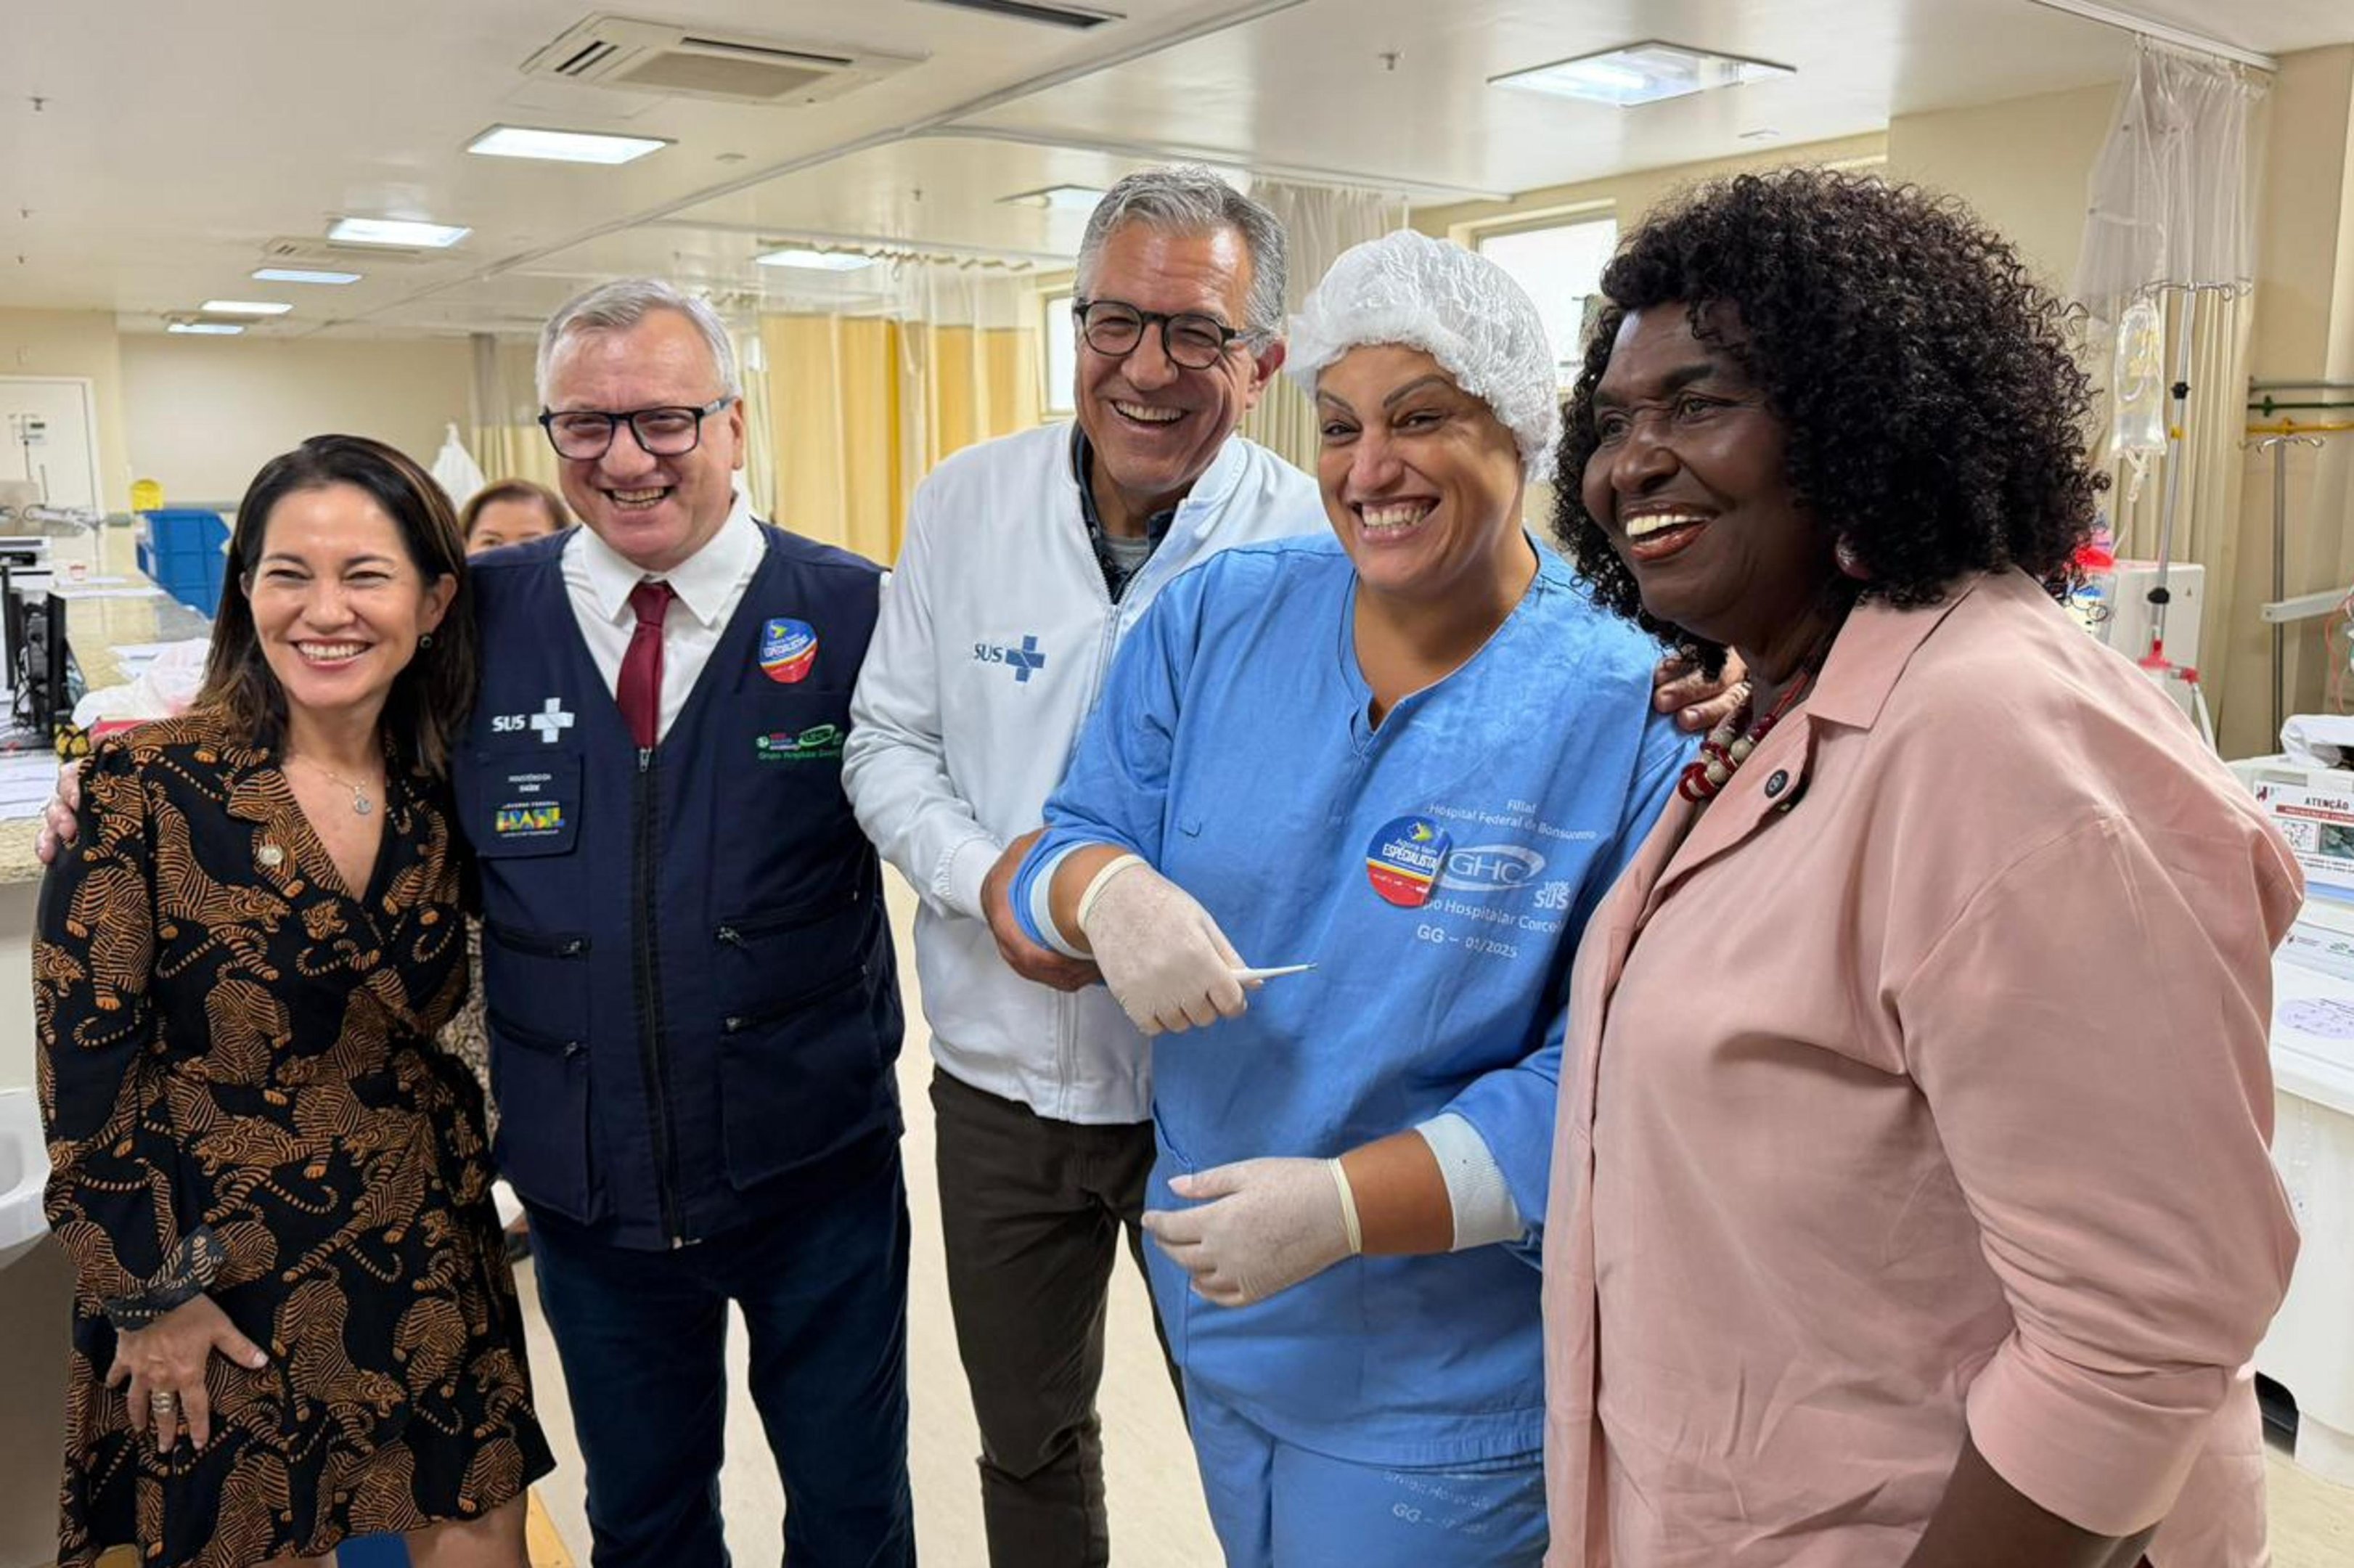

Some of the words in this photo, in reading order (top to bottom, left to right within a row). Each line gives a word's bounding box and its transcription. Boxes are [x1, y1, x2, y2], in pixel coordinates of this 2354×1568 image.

[974, 643, 1003, 663] SUS
[491, 715, 526, 732] SUS
[2305, 797, 2350, 810] ATENÇÃO
[1429, 803, 1476, 820] Hospital
[1479, 811, 1523, 829] Federal
[1448, 852, 1524, 885] GHC
[1533, 889, 1568, 910] SUS
[1444, 899, 1516, 925] Hospitalar
[1417, 924, 1445, 944] GG
[1465, 936, 1518, 958] 01/2025
[1393, 1503, 1423, 1523] GG
